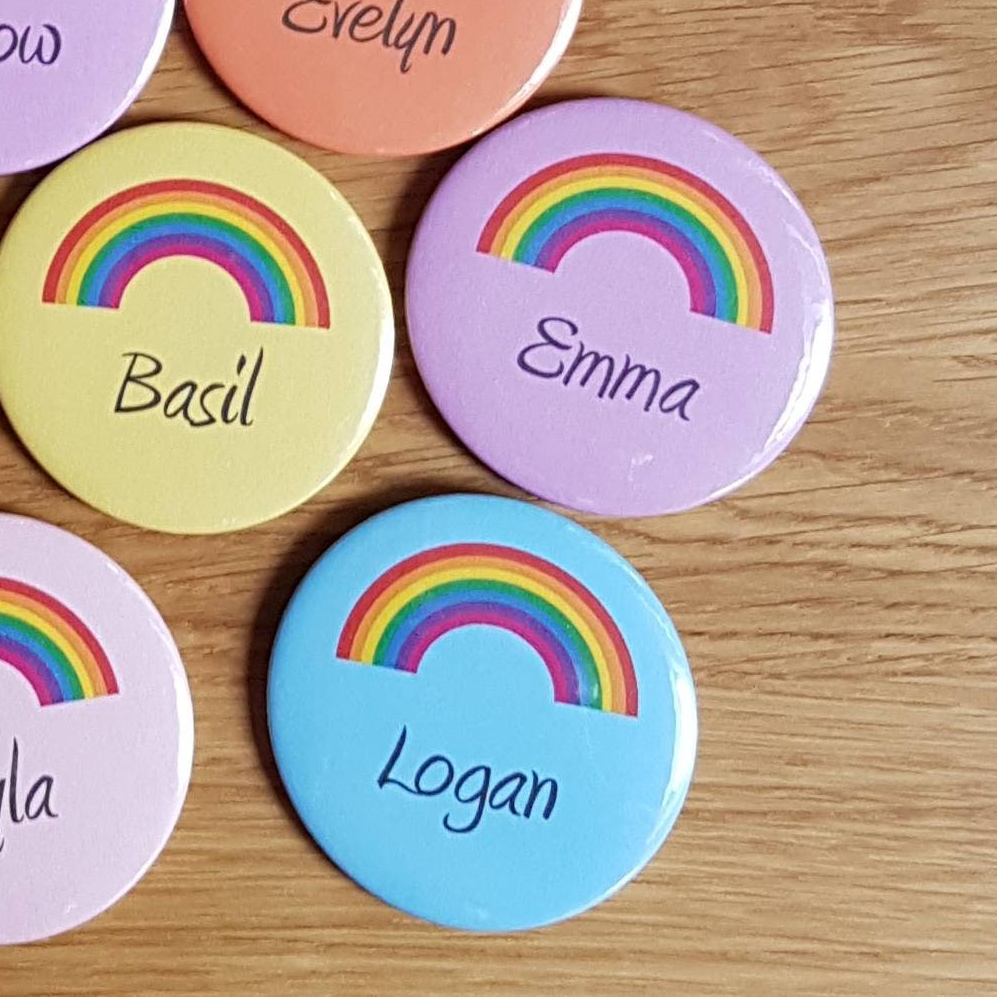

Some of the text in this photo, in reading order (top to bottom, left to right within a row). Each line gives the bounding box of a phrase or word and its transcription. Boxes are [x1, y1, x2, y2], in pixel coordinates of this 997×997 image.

[114, 347, 264, 428] Basil
[516, 316, 701, 421] Emma
[377, 725, 558, 834] Logan
